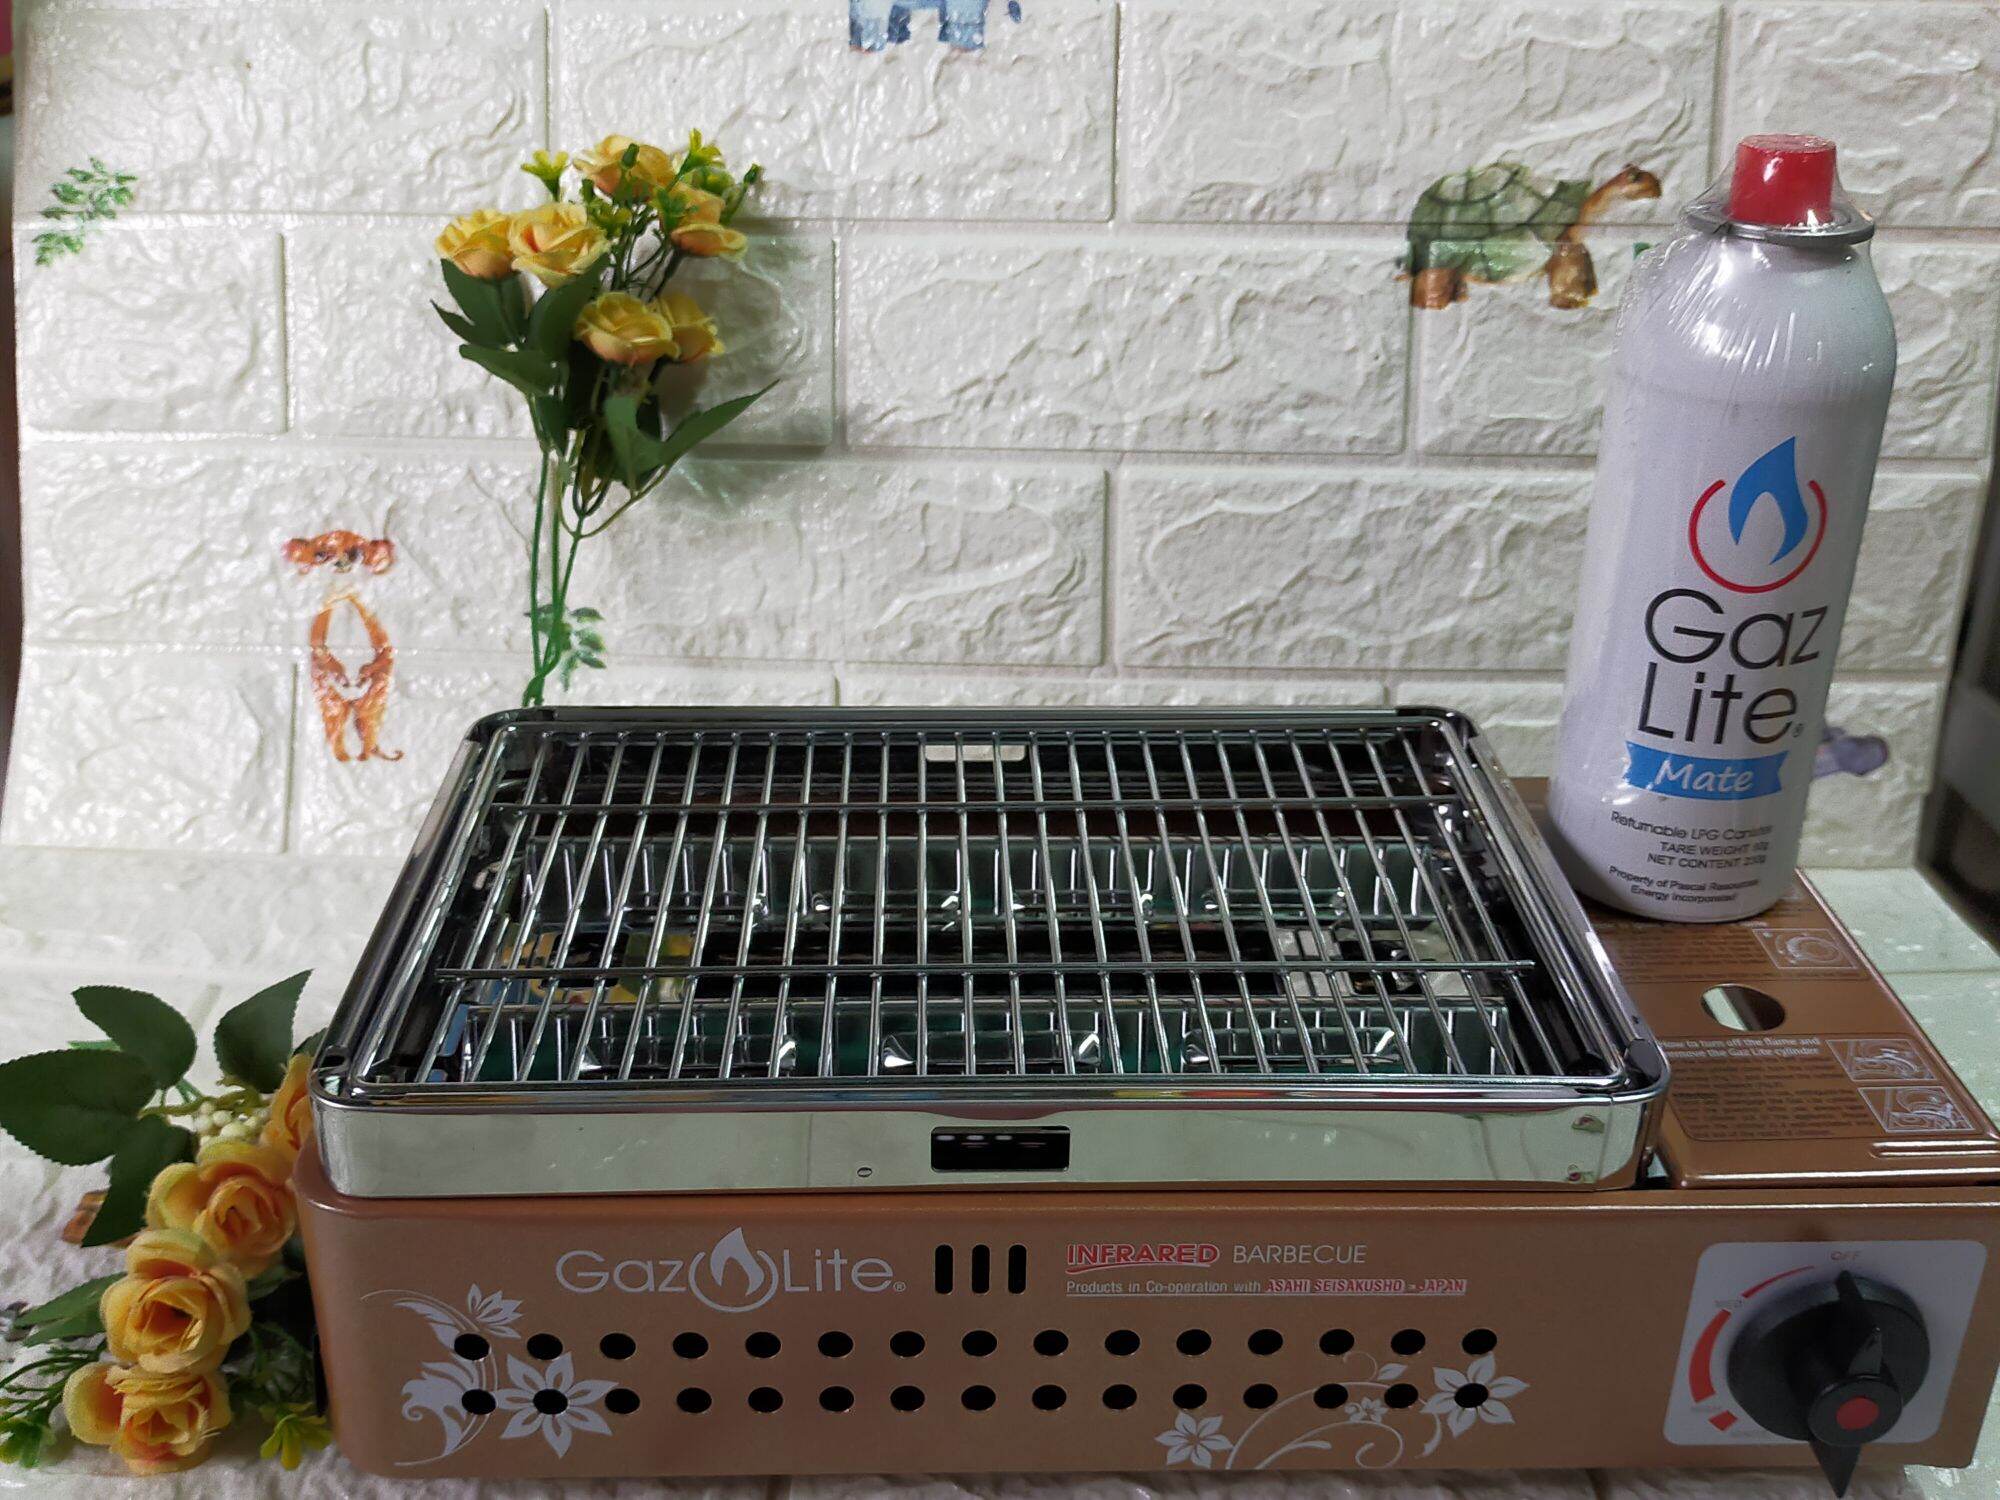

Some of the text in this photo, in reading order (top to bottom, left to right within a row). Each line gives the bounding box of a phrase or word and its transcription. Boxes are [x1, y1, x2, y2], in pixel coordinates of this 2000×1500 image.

[1645, 589, 1828, 669] Gaz
[1638, 662, 1797, 744] Lite
[1653, 760, 1754, 793] Mate
[1691, 828, 1718, 840] LPG
[1660, 841, 1697, 855] TARE
[1699, 844, 1748, 856] WEIGHT
[1647, 853, 1676, 866] NET
[1678, 857, 1740, 869] CONTENT
[1609, 866, 1654, 887] Property
[1656, 879, 1668, 888] of
[1631, 885, 1669, 901] Energy
[1685, 1040, 1698, 1048] to
[1727, 1038, 1741, 1047] off
[1800, 1037, 1820, 1045] and
[1066, 1243, 1368, 1266] INFRARED BARBECUE
[556, 1250, 687, 1293] Gaz
[1066, 1280, 1123, 1293] Products
[1128, 1280, 1141, 1293] in
[1146, 1280, 1228, 1295] Co-operation
[1233, 1281, 1262, 1293] with
[1265, 1278, 1311, 1293] ASAHI
[1313, 1278, 1403, 1293] SEISAKUSHO
[1417, 1278, 1467, 1293] JAPAN
